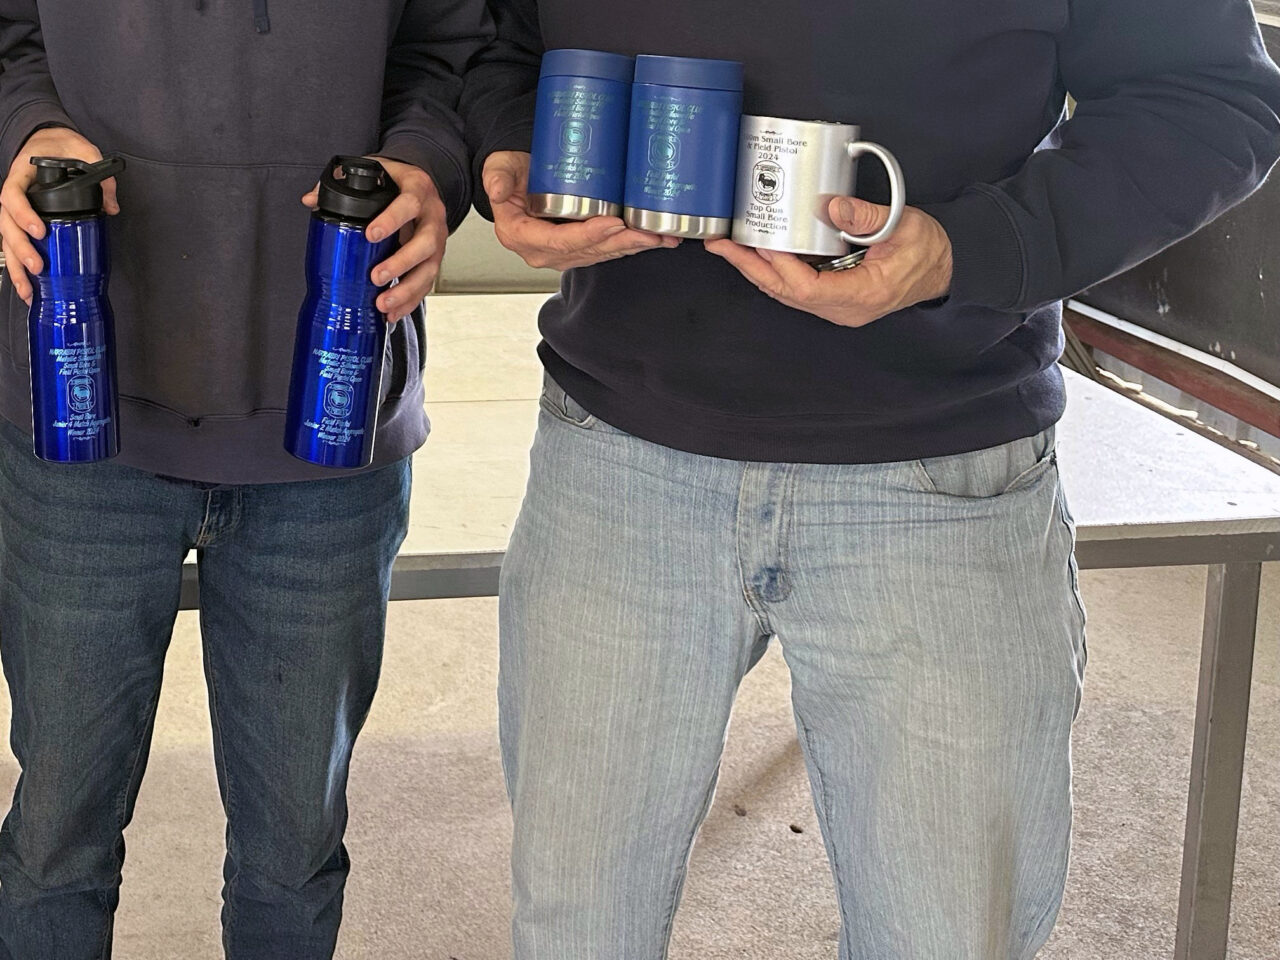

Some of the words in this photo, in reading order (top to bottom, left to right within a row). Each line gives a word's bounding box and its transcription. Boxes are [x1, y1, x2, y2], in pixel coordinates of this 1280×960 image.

[761, 136, 783, 144] Small
[786, 138, 807, 146] Bore
[754, 143, 771, 151] Field
[774, 145, 798, 154] Pistol
[758, 153, 779, 161] 2024
[750, 203, 763, 212] Top
[765, 205, 783, 213] Gun
[746, 210, 765, 220] Small
[767, 214, 788, 222] Bore
[745, 218, 788, 230] Production
